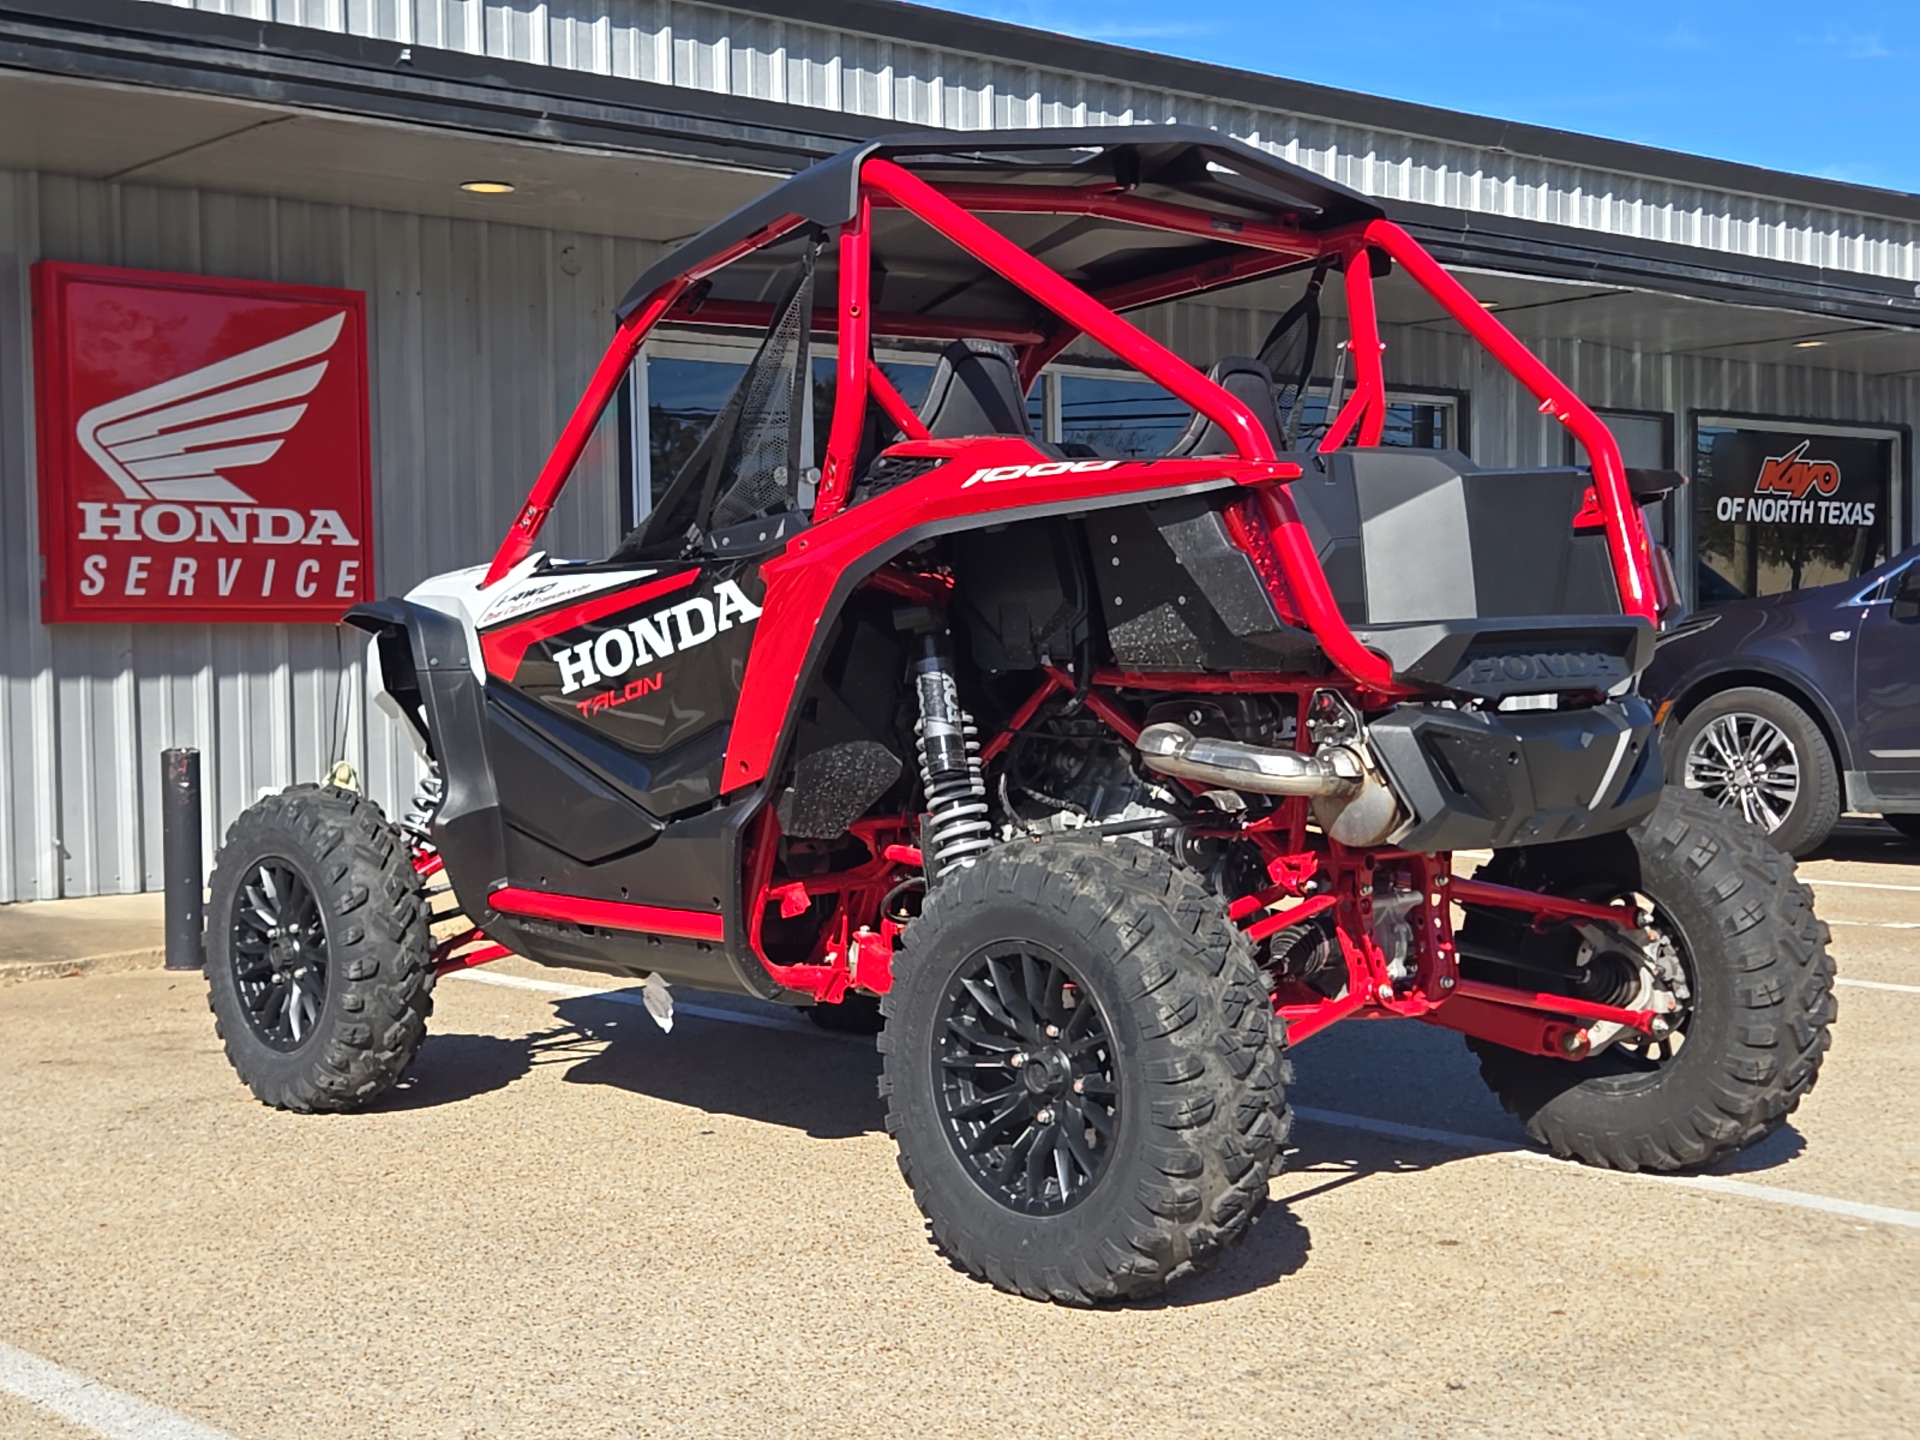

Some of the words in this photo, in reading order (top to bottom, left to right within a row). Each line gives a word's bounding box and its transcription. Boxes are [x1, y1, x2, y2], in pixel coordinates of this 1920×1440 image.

[961, 460, 1121, 488] 1000
[77, 502, 360, 546] HONDA
[1716, 496, 1745, 521] OF
[1747, 498, 1814, 524] NORTH
[1818, 501, 1875, 525] TEXAS
[80, 554, 360, 598] SERVICE
[552, 579, 763, 695] HONDA
[1470, 652, 1620, 685] HONDA
[576, 672, 664, 718] TALON
